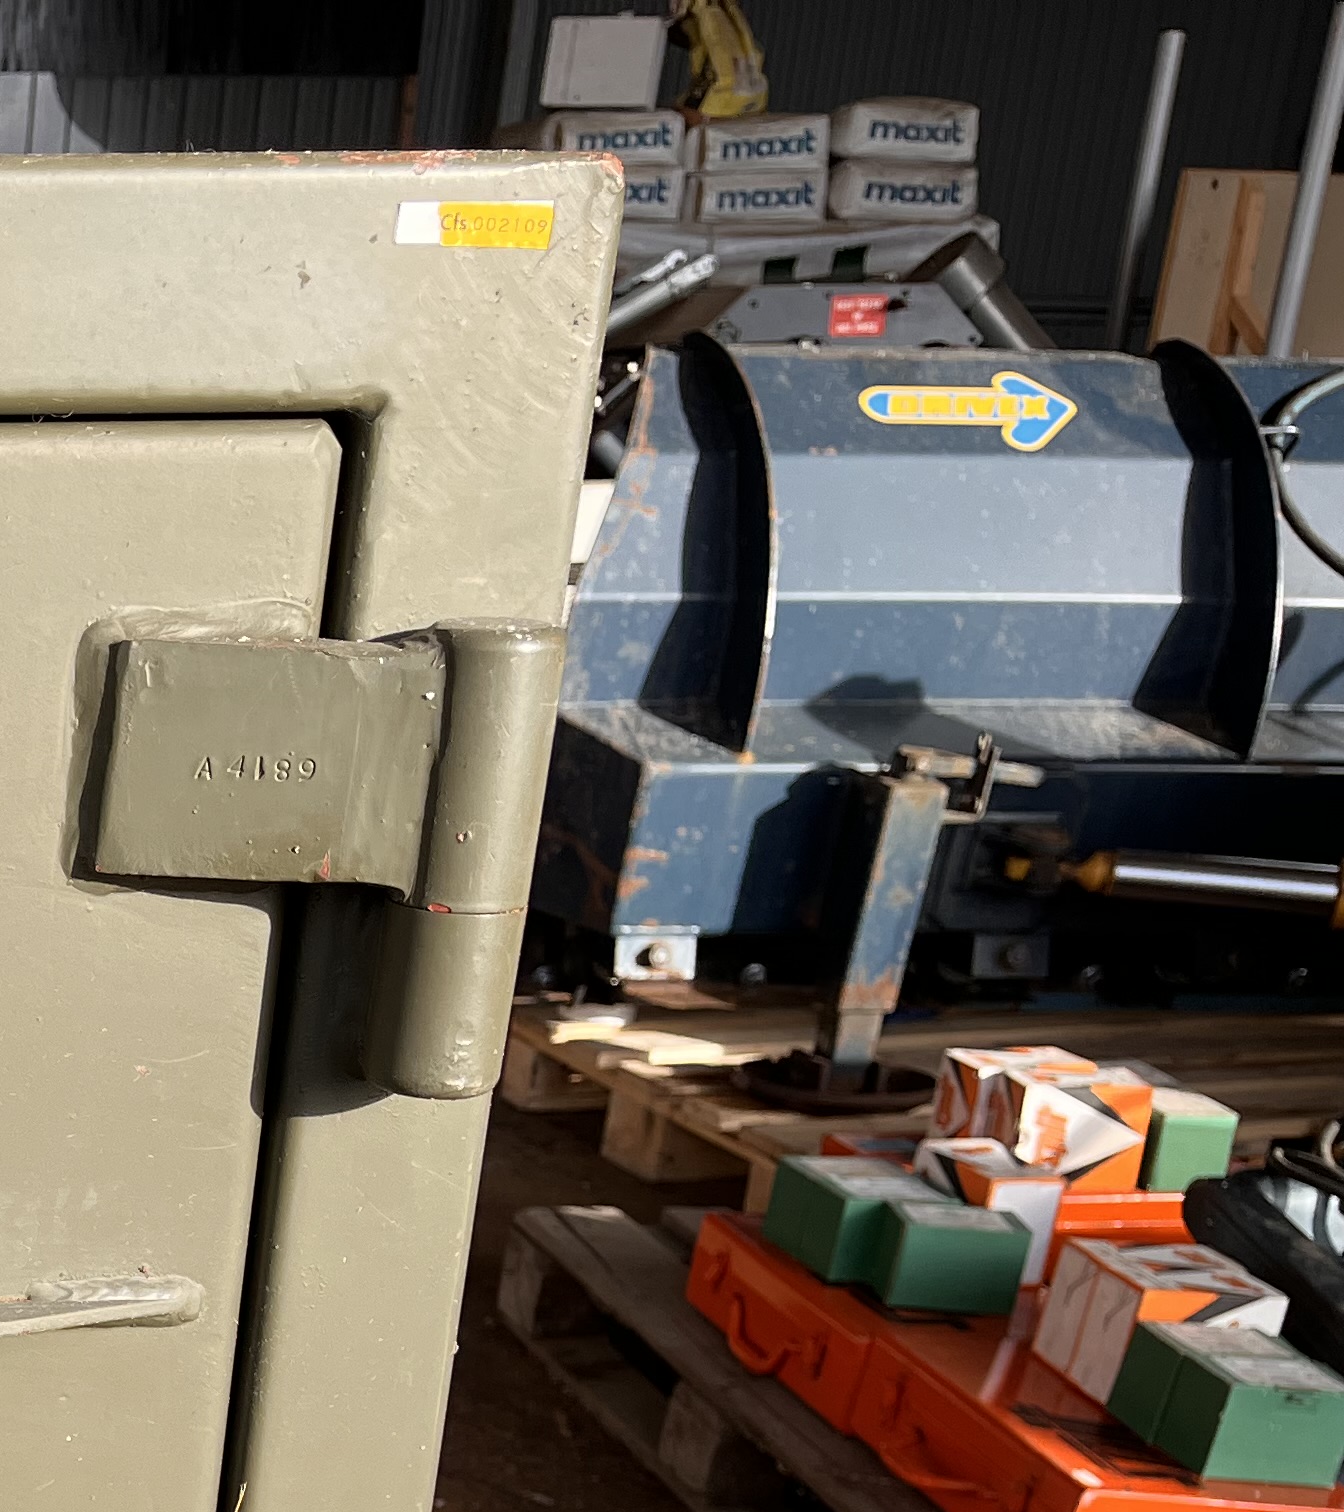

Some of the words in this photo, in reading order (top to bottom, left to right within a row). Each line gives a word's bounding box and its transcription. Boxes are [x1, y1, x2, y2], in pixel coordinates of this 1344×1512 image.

[578, 122, 672, 150] maxit
[722, 128, 816, 160] maxit
[870, 119, 964, 143] maxit
[625, 178, 669, 204] xit
[717, 181, 815, 212] maxit
[865, 179, 961, 204] maxit
[473, 216, 548, 234] 002109
